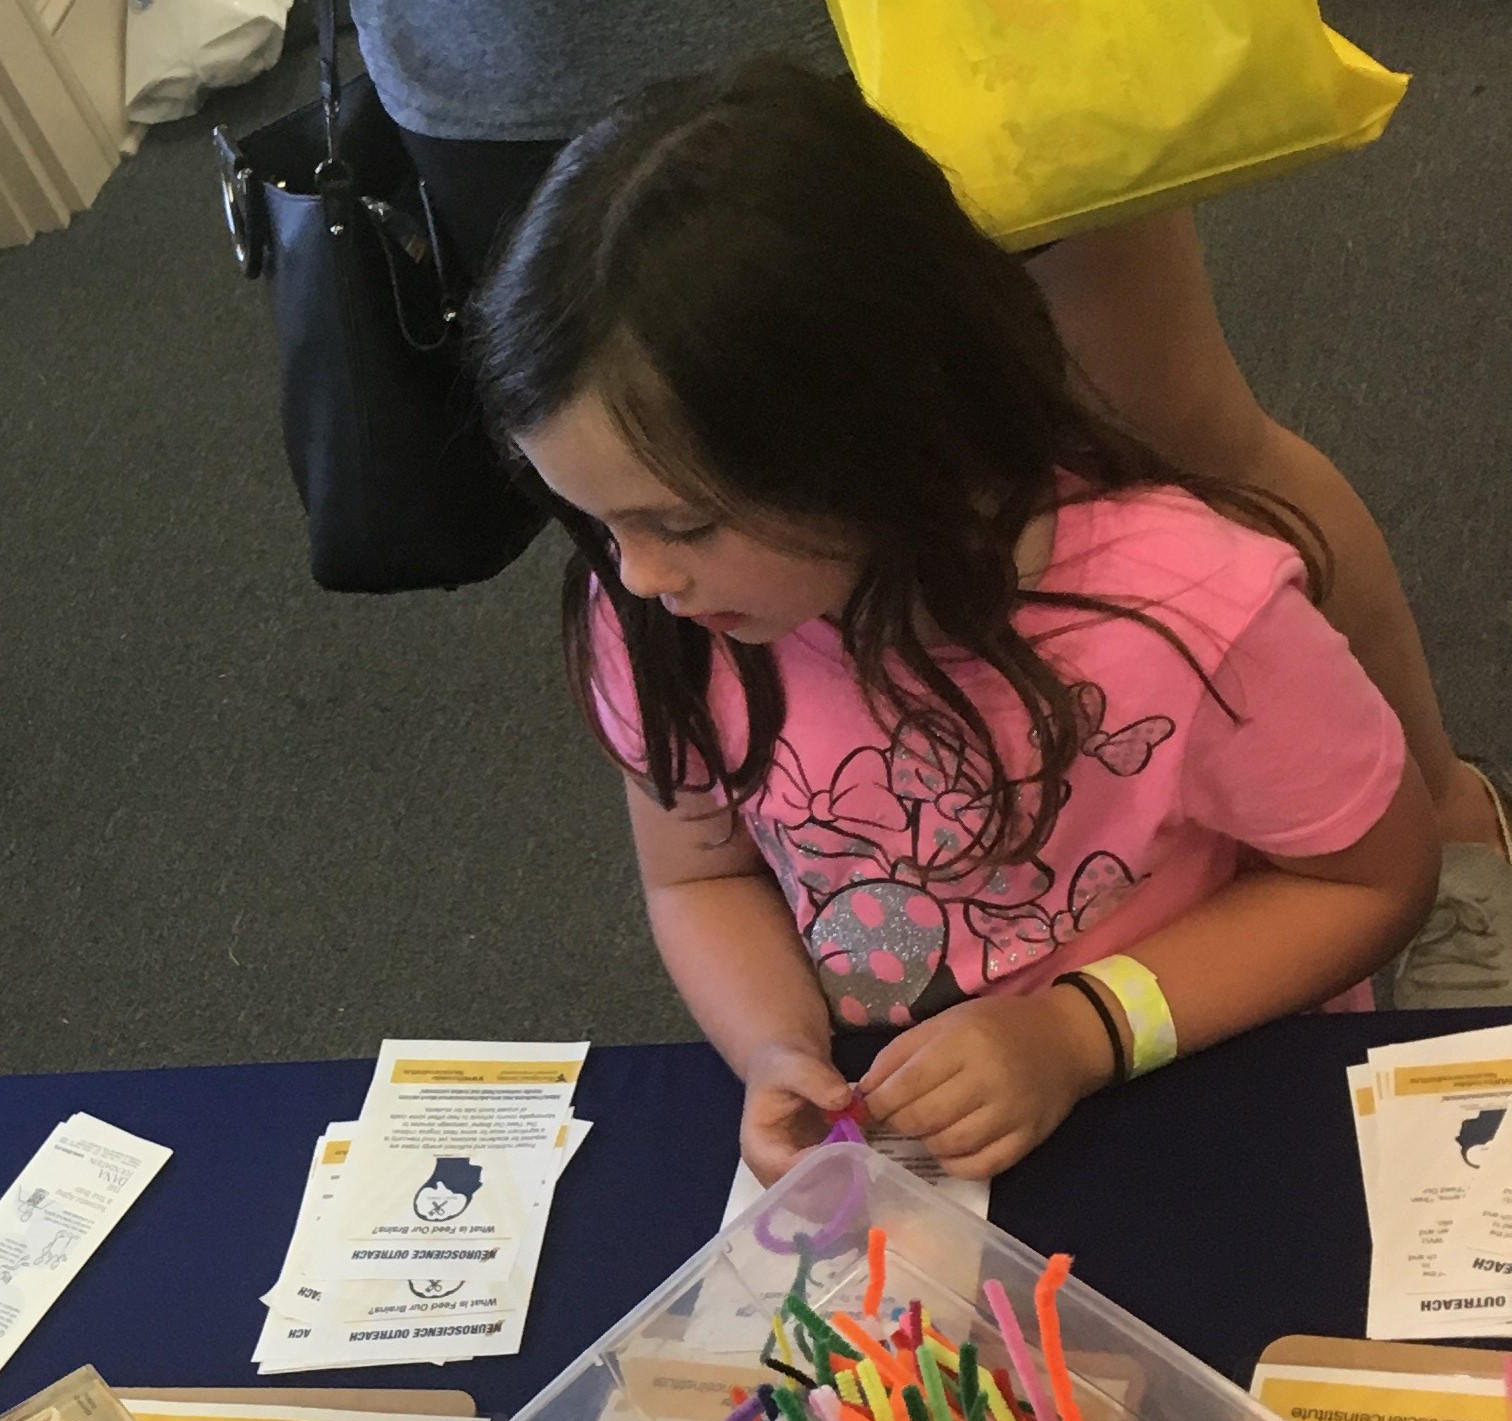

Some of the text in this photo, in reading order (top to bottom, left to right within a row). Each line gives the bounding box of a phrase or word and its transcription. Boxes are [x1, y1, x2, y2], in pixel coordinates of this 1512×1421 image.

[351, 1248, 497, 1260] NEUROSCIENCE OUTREACH
[471, 1298, 497, 1308] What
[1420, 1296, 1506, 1312] OUTREACH
[349, 1322, 502, 1341] NEUROSCIENCE OUTREACH
